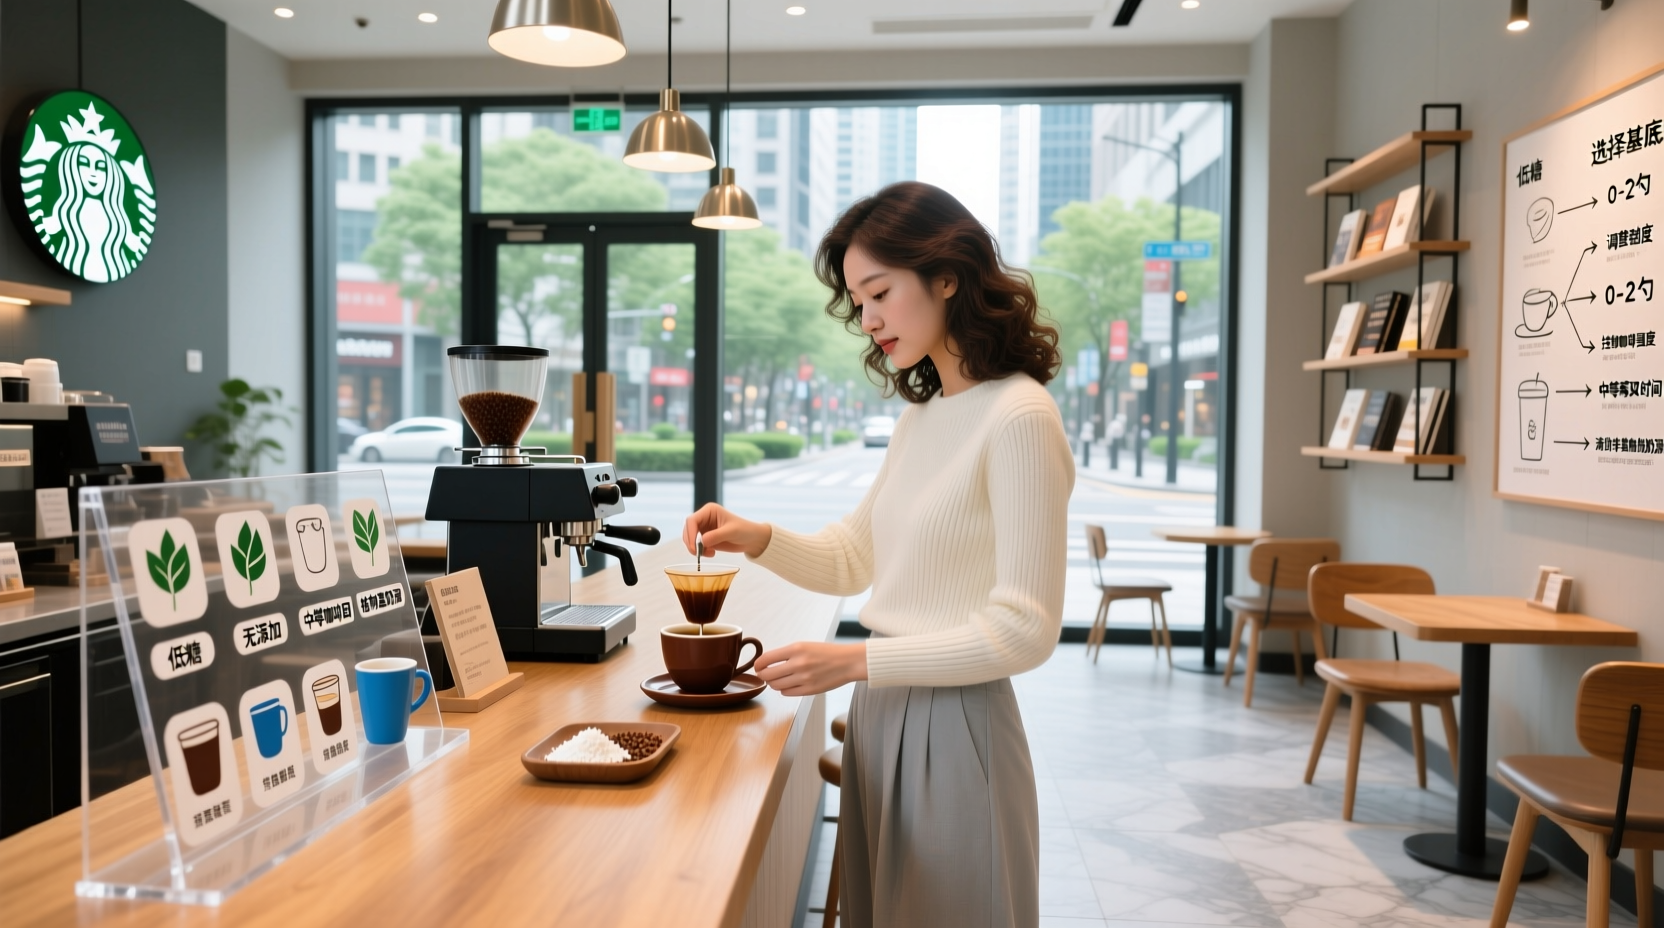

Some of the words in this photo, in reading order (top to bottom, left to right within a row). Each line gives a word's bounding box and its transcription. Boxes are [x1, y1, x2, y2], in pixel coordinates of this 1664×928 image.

[1591, 118, 1664, 166] 选择基底
[1516, 158, 1543, 188] 低糖
[1607, 172, 1651, 204] 0-2勺
[1605, 276, 1653, 305] 0-2勺
[168, 641, 203, 672] 低糖
